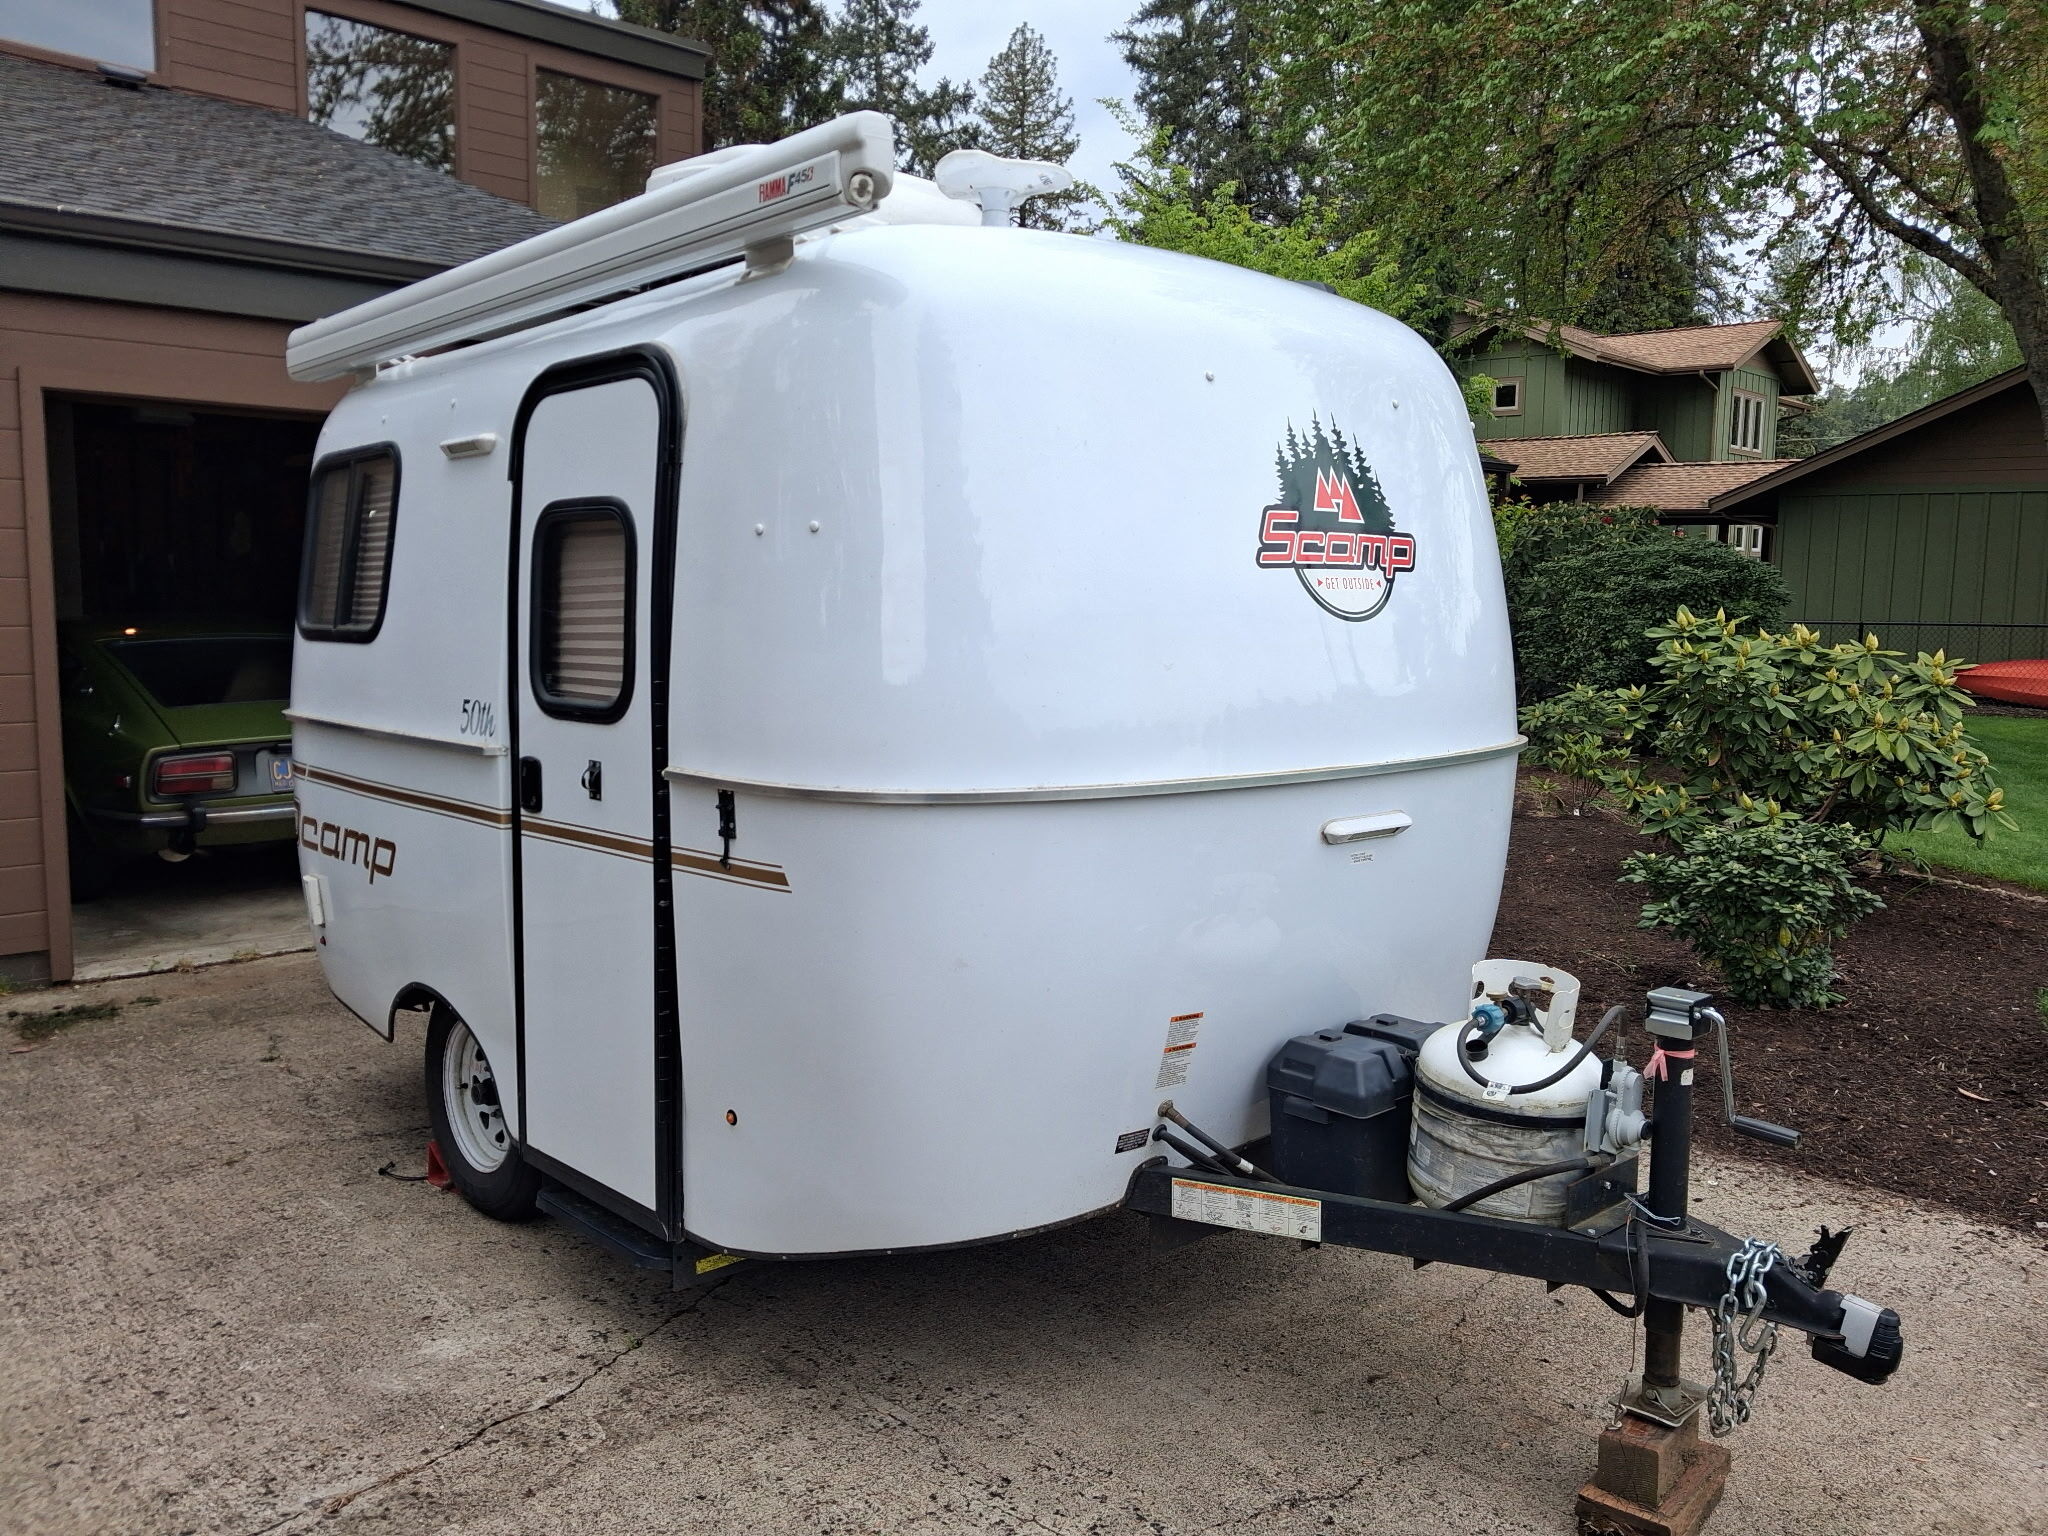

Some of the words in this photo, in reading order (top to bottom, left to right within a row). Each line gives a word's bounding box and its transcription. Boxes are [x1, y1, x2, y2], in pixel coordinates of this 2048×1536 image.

[759, 175, 786, 204] FIAMMA
[1257, 506, 1415, 581] Scamp
[1325, 576, 1339, 590] GET
[1342, 577, 1375, 591] OUTSIDE
[460, 698, 497, 738] 50th
[298, 804, 397, 886] camp
